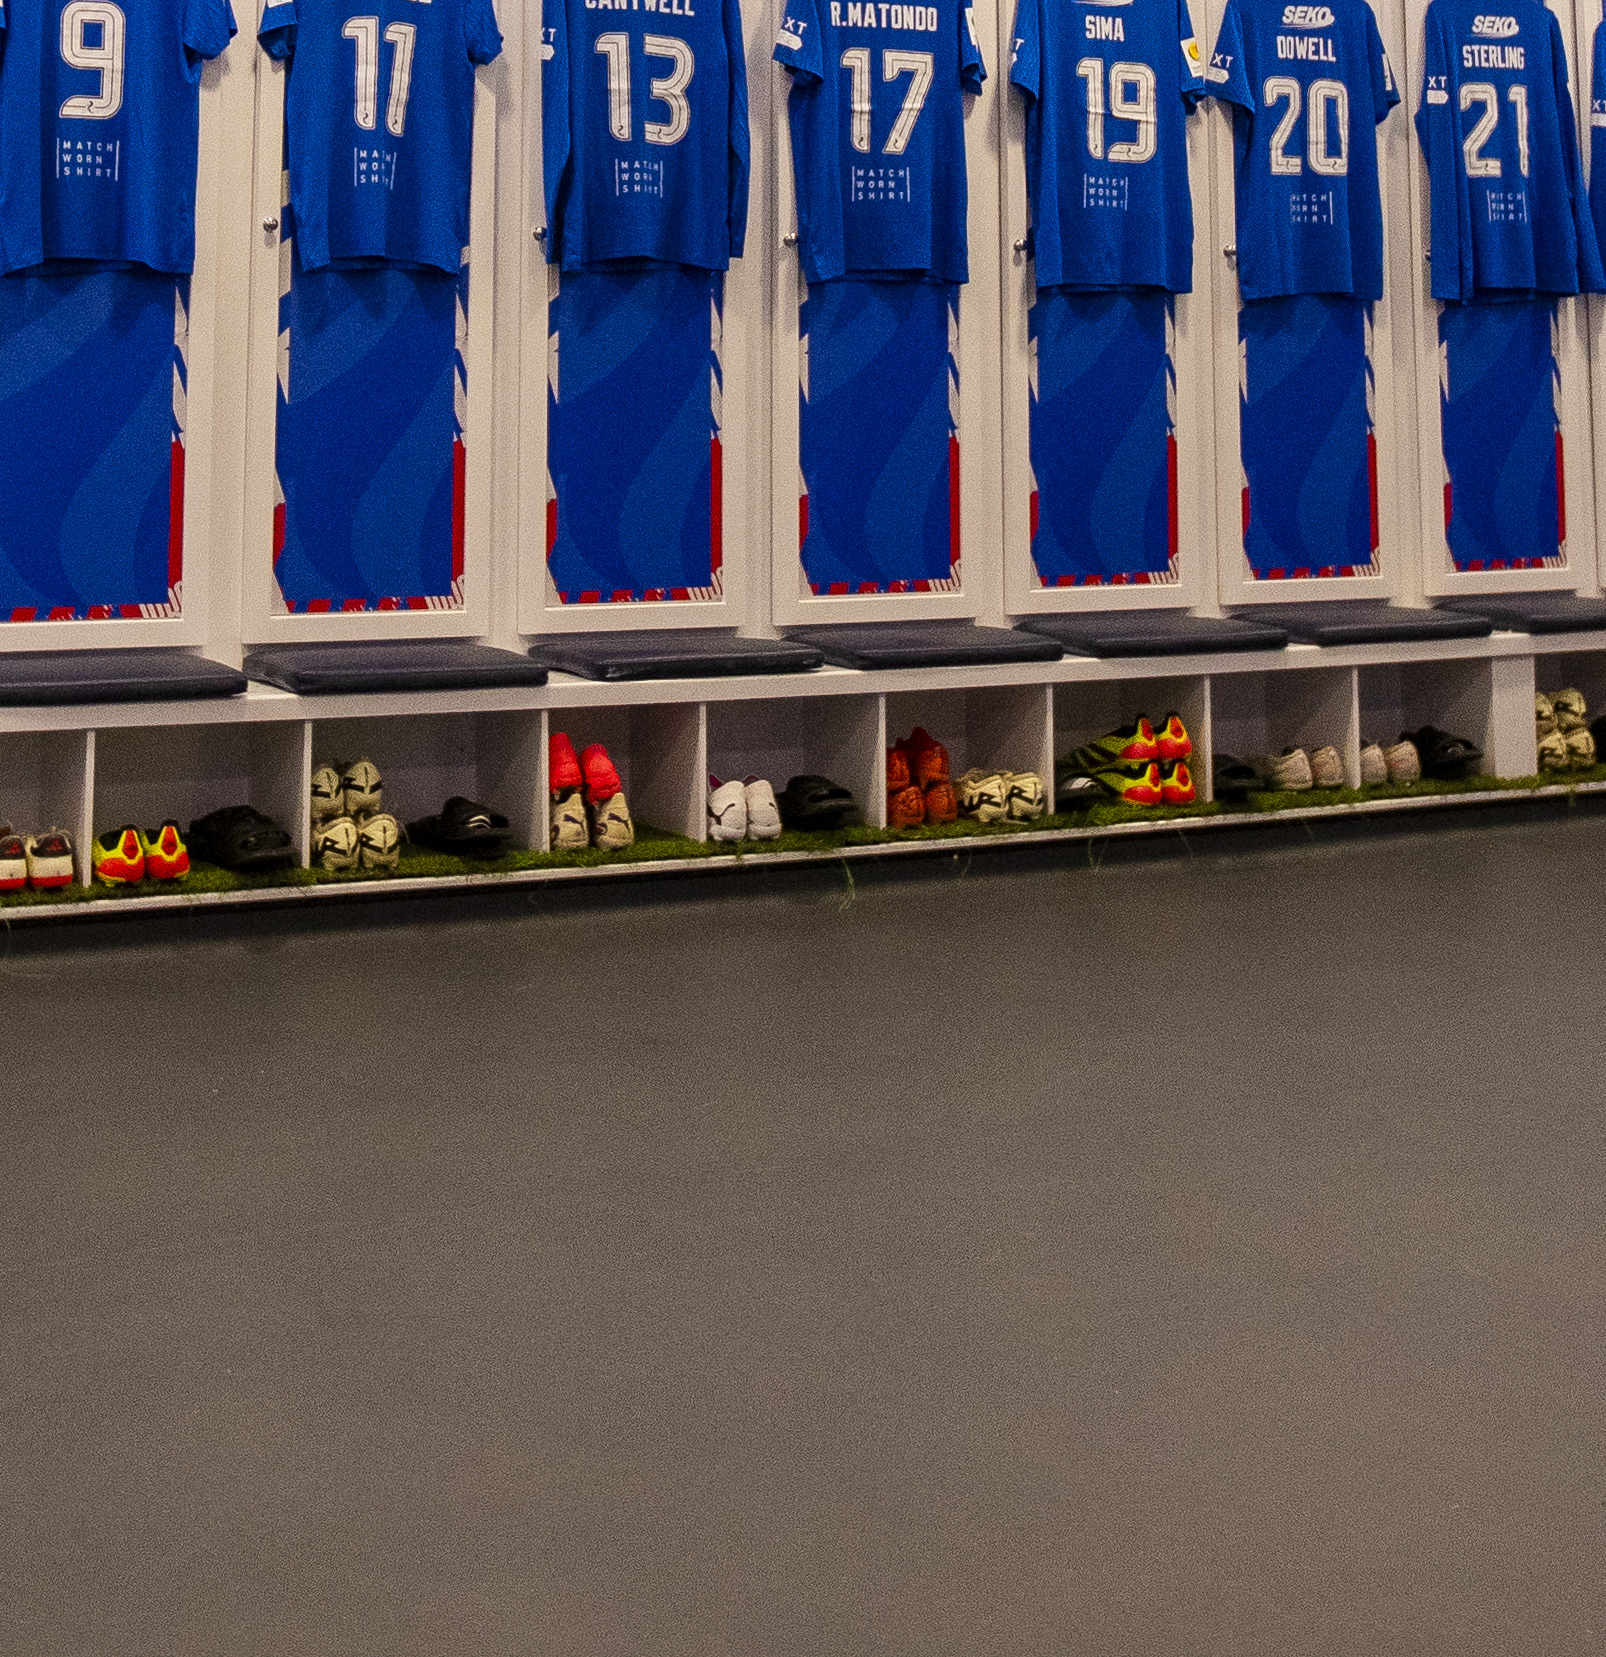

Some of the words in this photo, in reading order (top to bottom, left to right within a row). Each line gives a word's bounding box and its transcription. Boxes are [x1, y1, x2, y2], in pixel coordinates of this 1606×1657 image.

[830, 1, 937, 31] R.MATONDO
[1085, 15, 1125, 42] SIMA
[1282, 5, 1335, 29] SEKO
[1471, 15, 1519, 38] SEKO
[1276, 35, 1337, 62] DOWELL
[1463, 45, 1525, 70] STERLING
[342, 16, 416, 136] 11
[595, 31, 695, 145] 13
[840, 47, 934, 154] 17
[1076, 57, 1157, 164] 19
[1263, 76, 1349, 176] 20
[1459, 81, 1529, 178] 21
[63, 140, 113, 152] MATCH
[63, 154, 103, 164] WORN
[63, 167, 112, 177] SHIRT
[857, 169, 905, 178] MATCH
[857, 180, 896, 189] WORN
[858, 191, 905, 200] SHIRT
